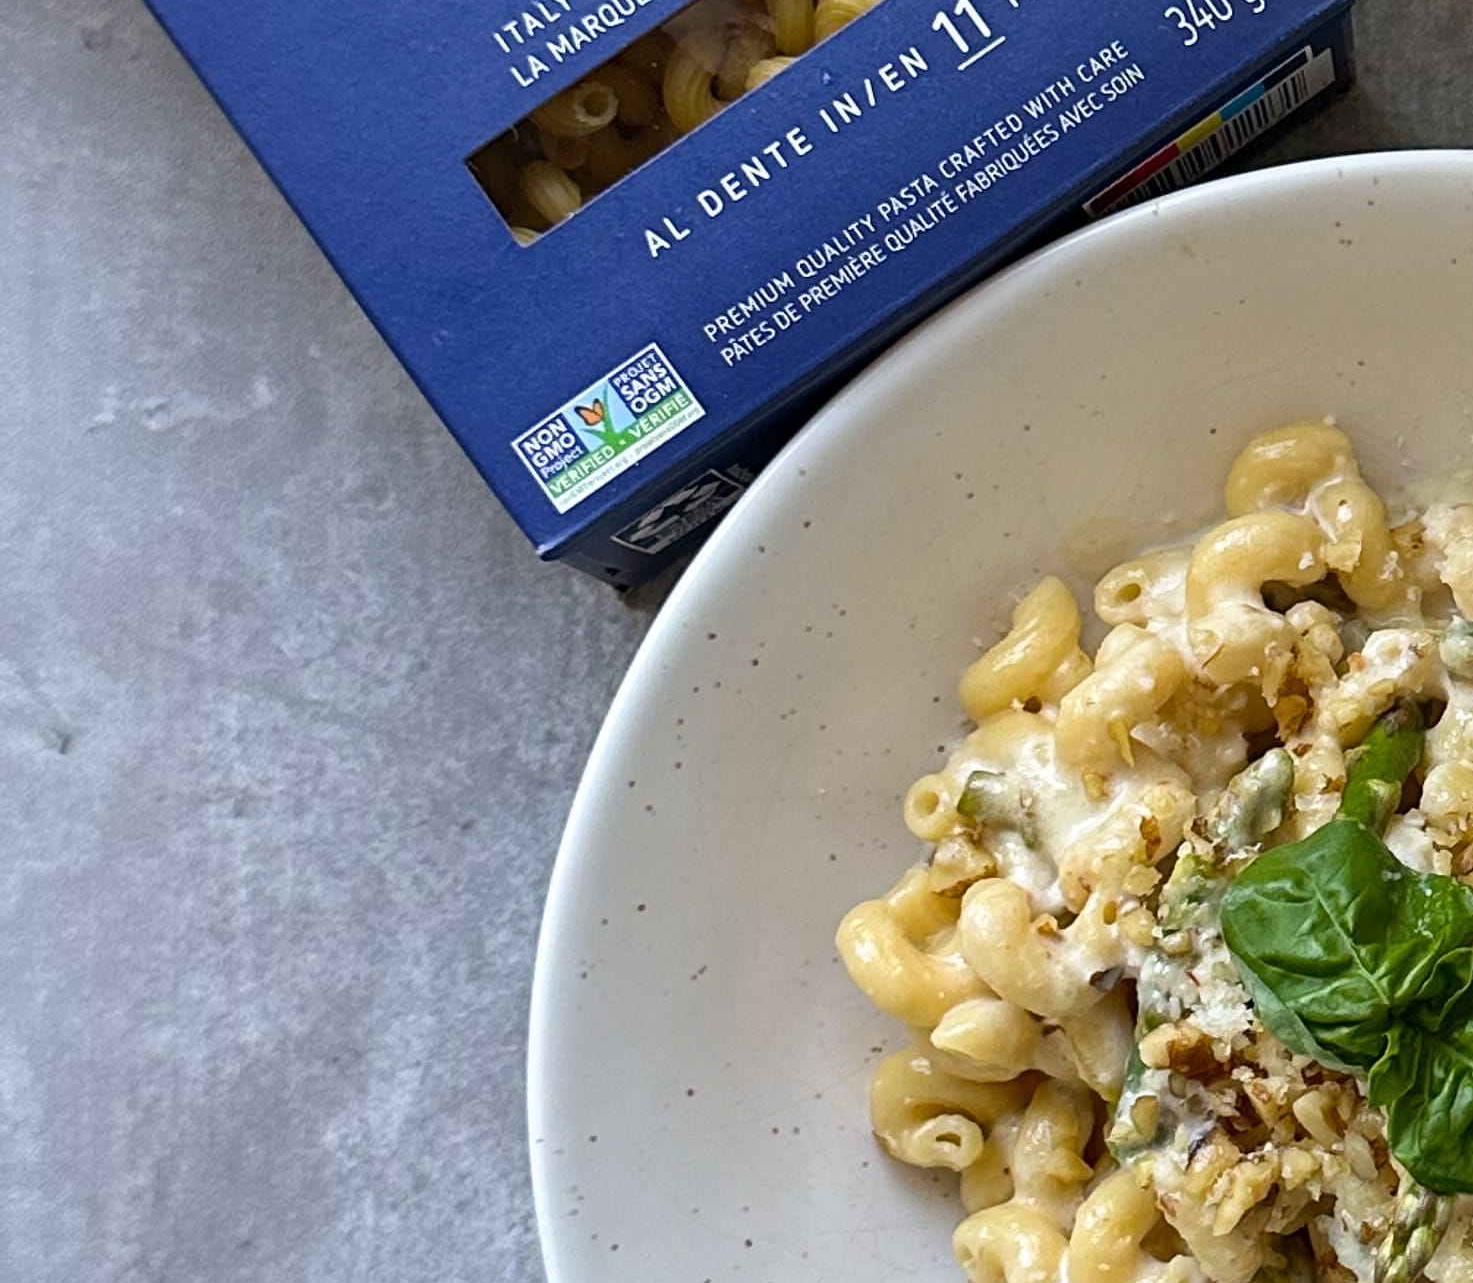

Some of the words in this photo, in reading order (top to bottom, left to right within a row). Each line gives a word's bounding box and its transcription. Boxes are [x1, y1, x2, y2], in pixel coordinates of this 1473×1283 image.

[509, 54, 550, 87] LA
[642, 218, 691, 259] AL
[697, 126, 814, 218] DENTE
[819, 48, 929, 133] IN/EN
[703, 271, 796, 343] PREMIUM
[795, 215, 879, 279] QUALITY
[877, 173, 939, 223] PASTA
[937, 112, 1024, 180] CRAFTED
[1022, 76, 1076, 122] WITH
[1076, 39, 1129, 86] CARE
[719, 320, 776, 367] PÂTES
[773, 299, 803, 330] DE
[799, 242, 887, 313] PREMIÈRE
[885, 188, 961, 254] QUALITÉ
[956, 120, 1060, 203] FABRIQUÉES
[1060, 97, 1105, 142] AVEC
[1100, 63, 1145, 103] SOIN
[613, 352, 657, 388] PROJET
[620, 362, 667, 401] SANS
[630, 377, 677, 413] OGM
[522, 417, 568, 456] NON
[532, 433, 576, 467] GMO
[539, 446, 585, 479] Project
[549, 445, 615, 494] VERIFIED
